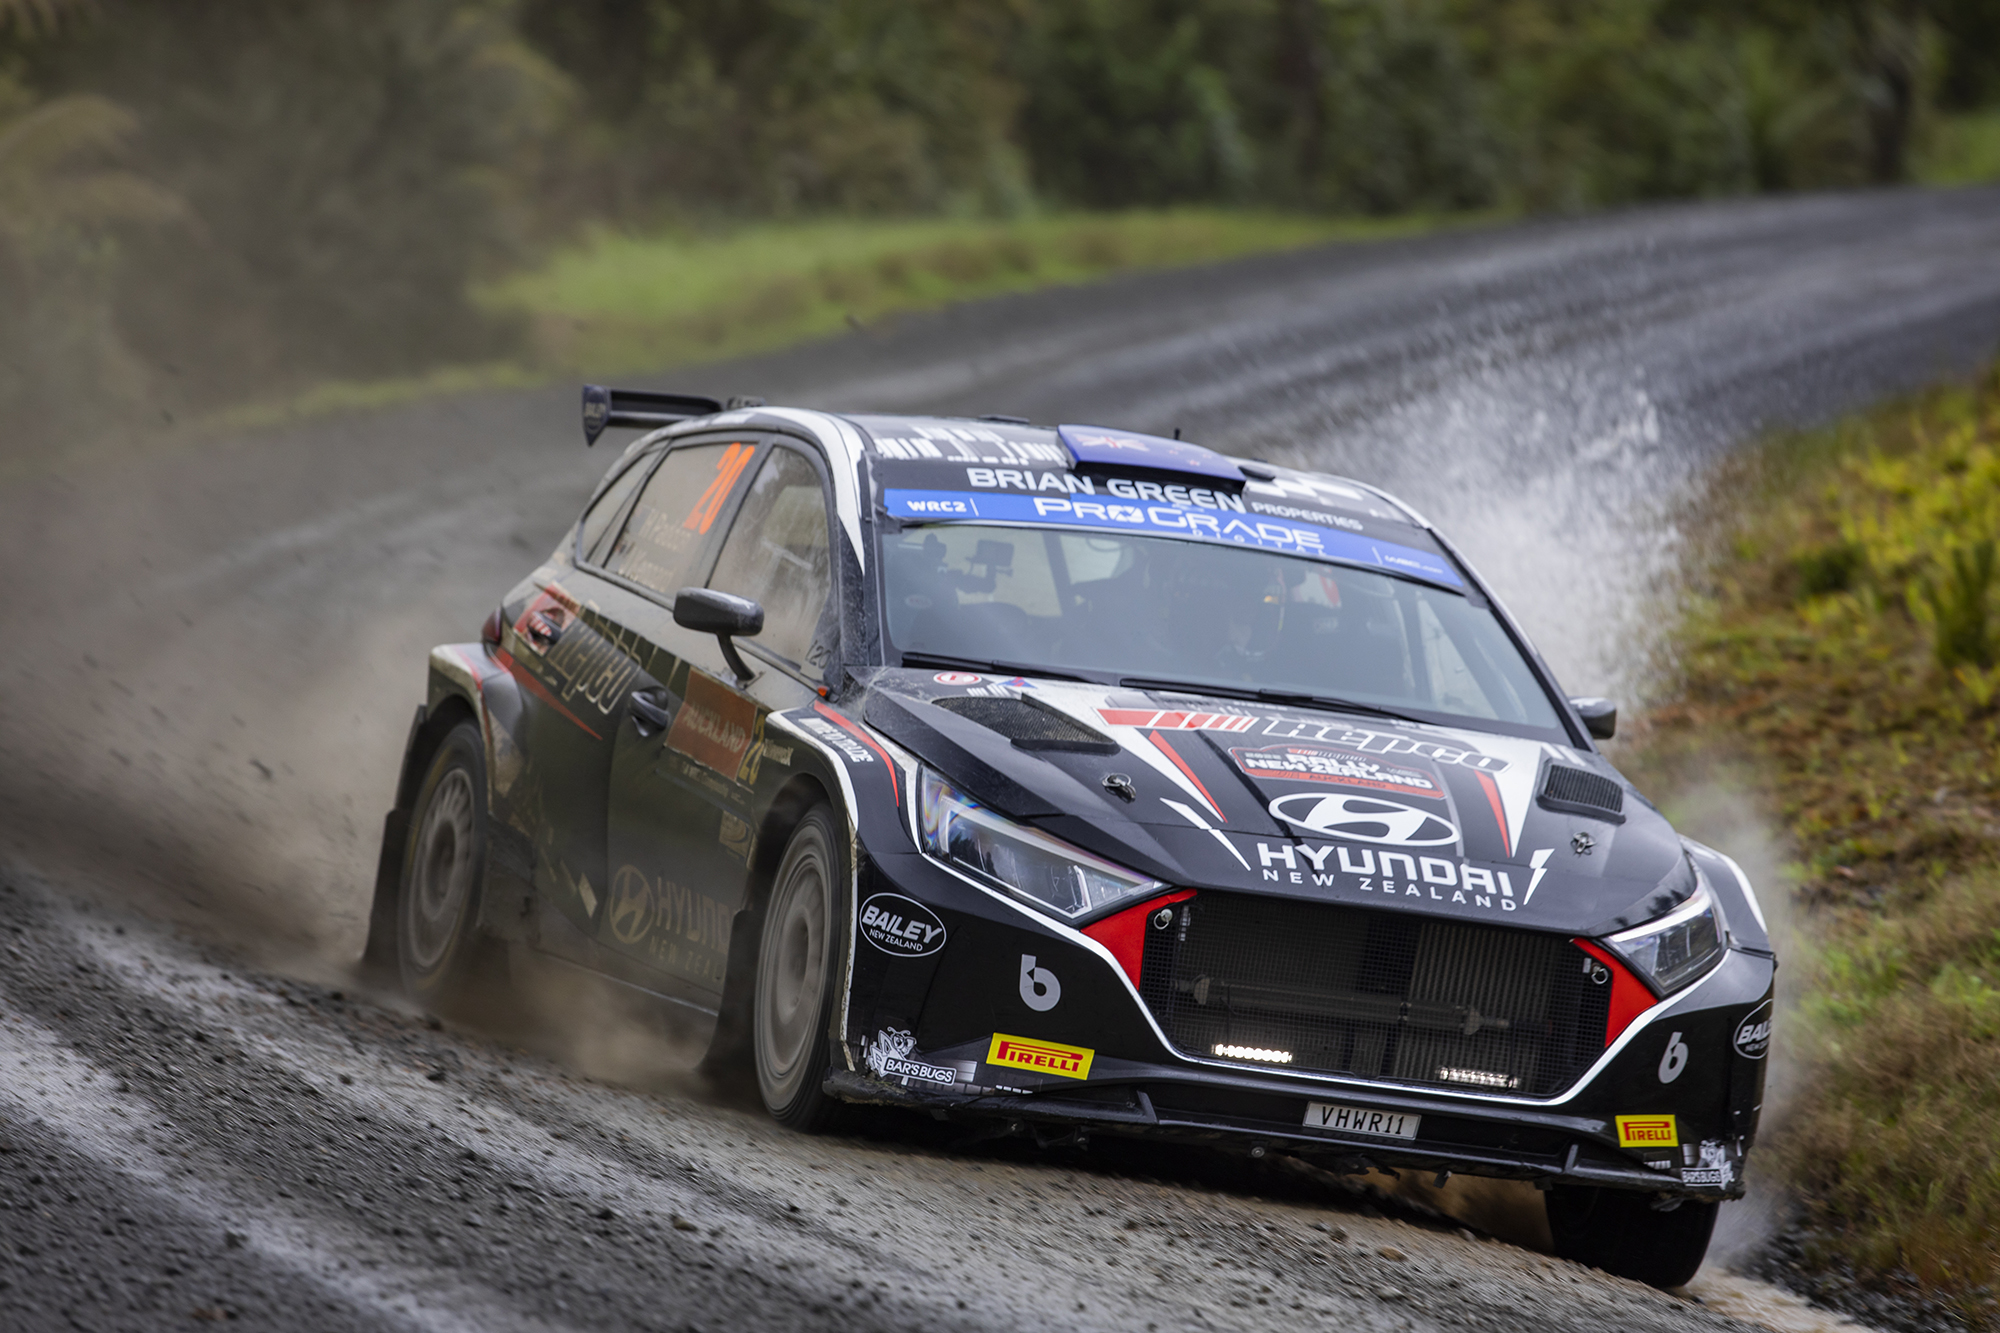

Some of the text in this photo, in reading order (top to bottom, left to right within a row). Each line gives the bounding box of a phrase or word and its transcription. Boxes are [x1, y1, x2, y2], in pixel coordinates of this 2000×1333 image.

[682, 441, 755, 535] 20
[966, 467, 1363, 531] BRIAN GREEN PROPERTIES
[907, 500, 967, 513] WRC2
[1246, 759, 1307, 772] NEW
[1310, 765, 1433, 789] ZEALAND
[1285, 753, 1380, 773] RALLY
[1257, 842, 1514, 897] HYUNDAI
[1263, 869, 1517, 912] NEW ZEALAND
[656, 876, 732, 955] HYUND
[862, 905, 943, 944] BAILEY
[869, 928, 923, 952] NEW ZEALAND
[996, 1040, 1084, 1073] PIRELLI
[1321, 1105, 1403, 1135] VHWR11
[1622, 1121, 1671, 1141] PIRELLI
